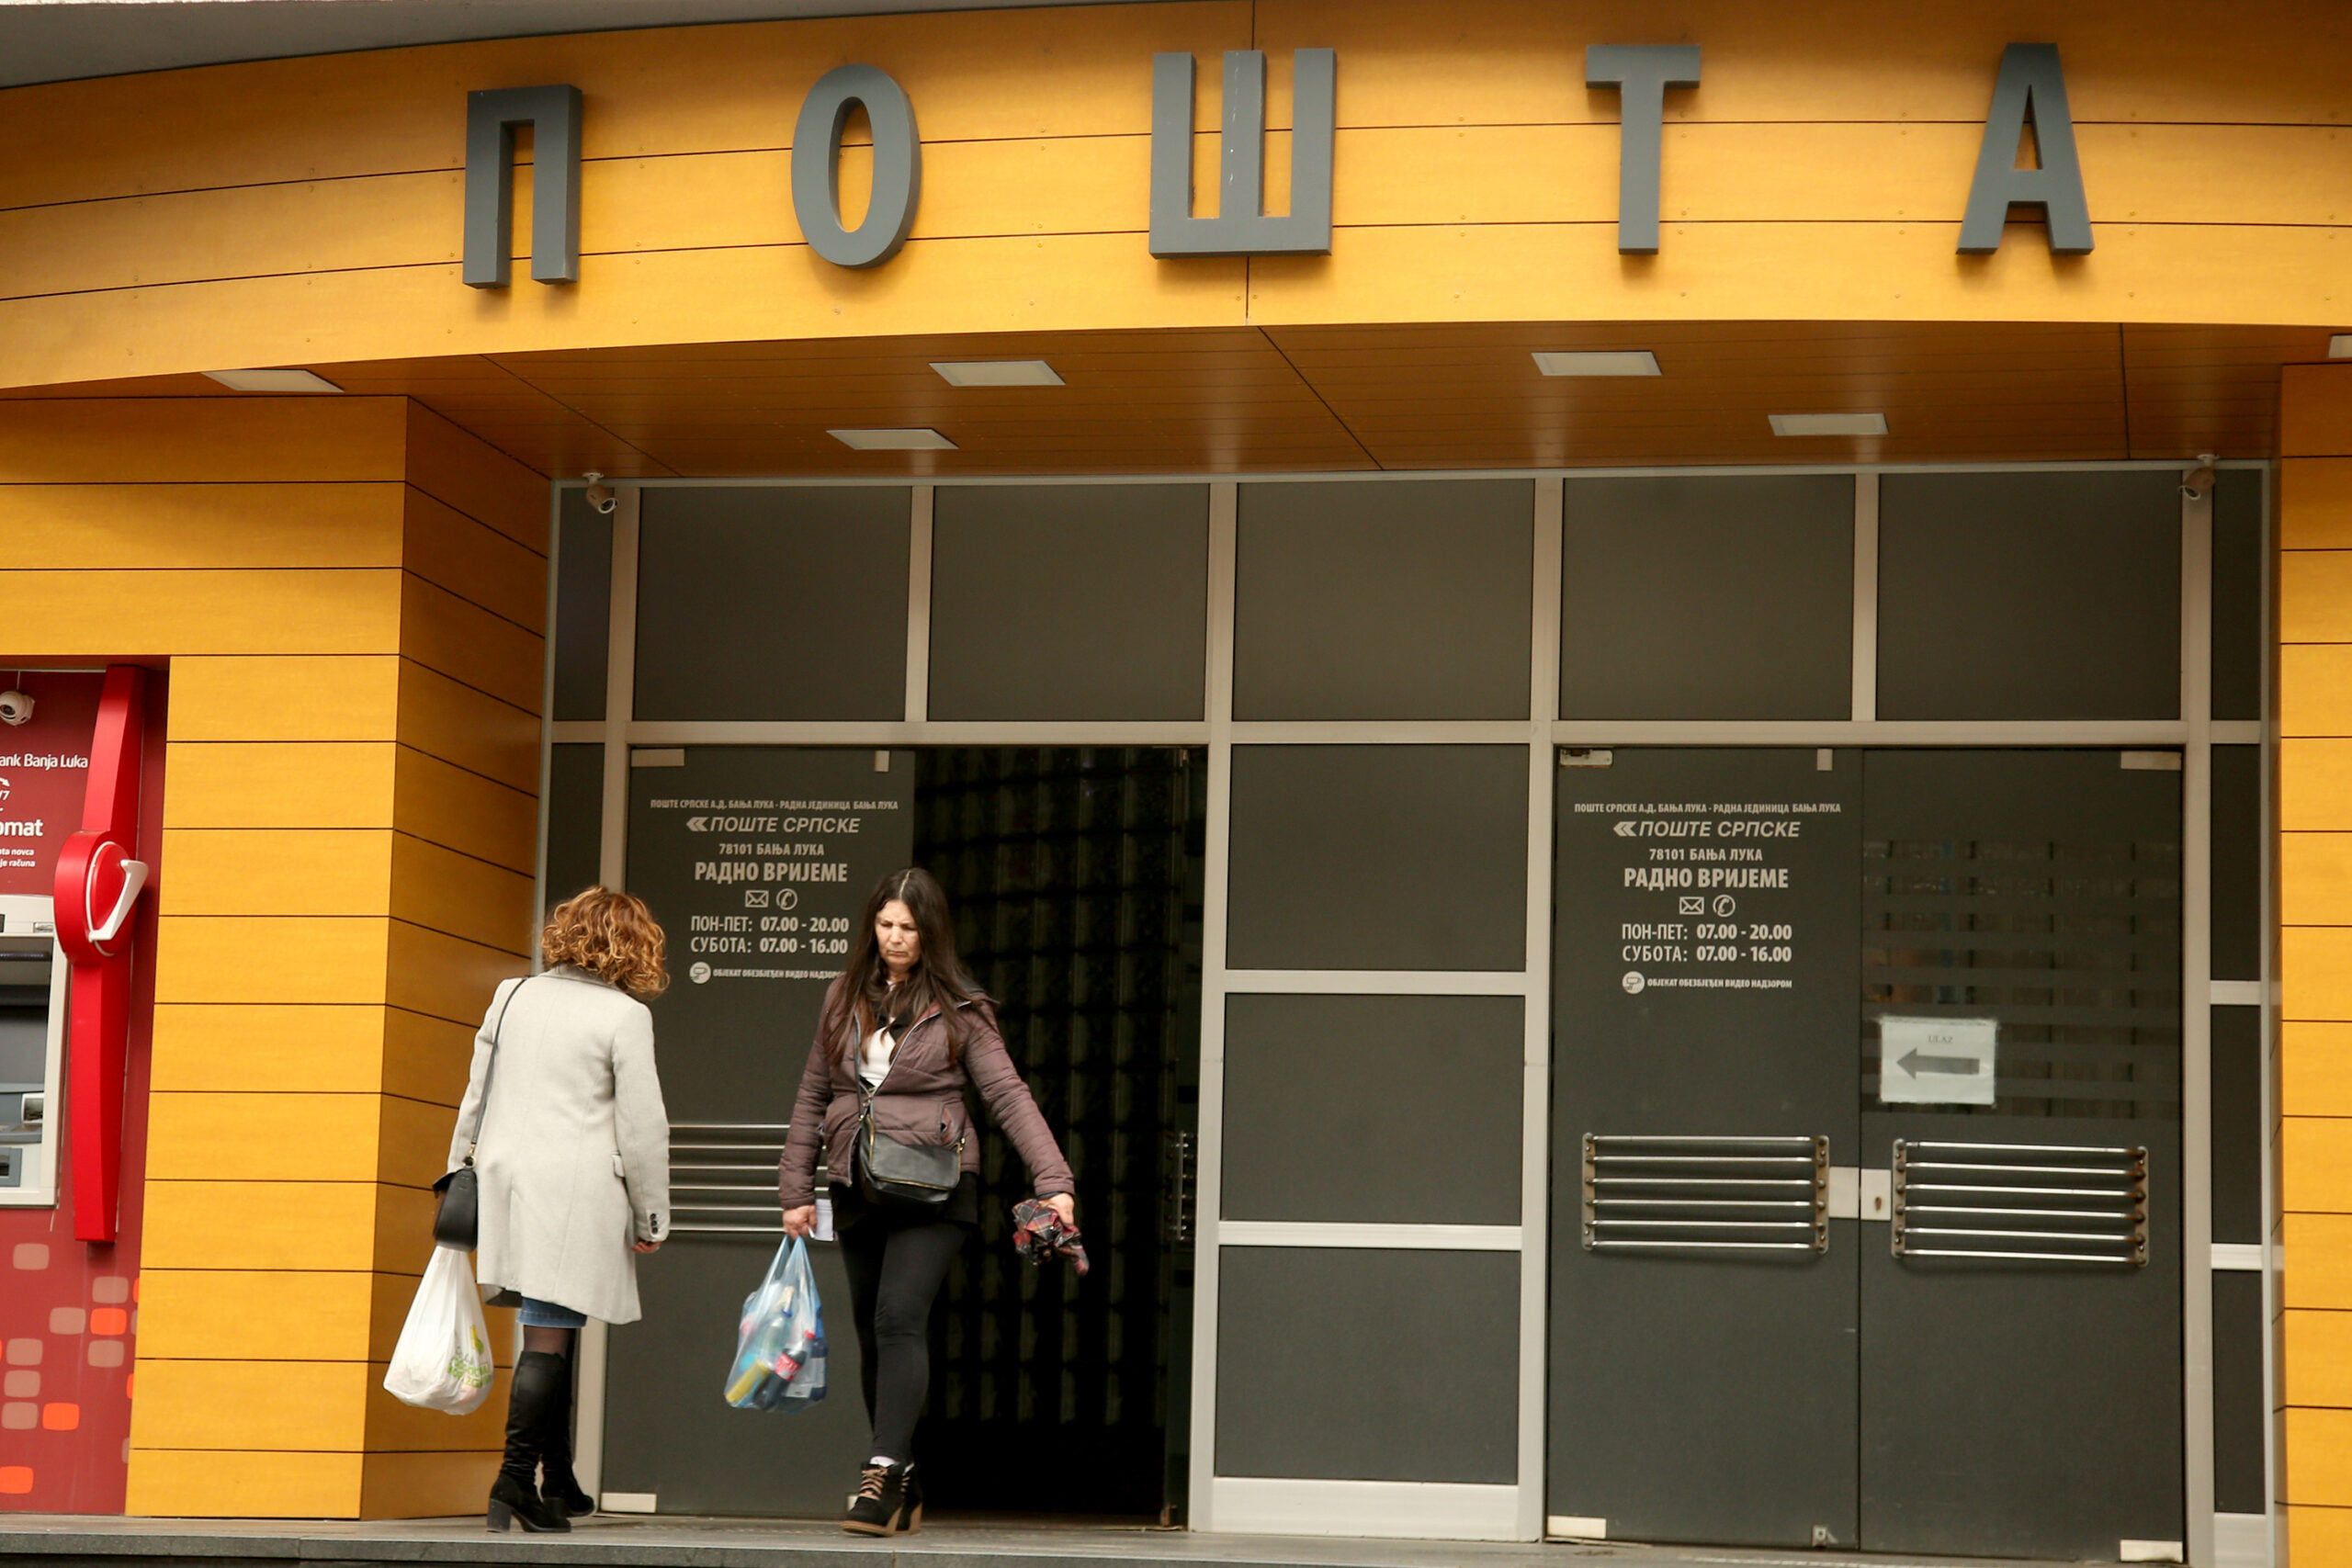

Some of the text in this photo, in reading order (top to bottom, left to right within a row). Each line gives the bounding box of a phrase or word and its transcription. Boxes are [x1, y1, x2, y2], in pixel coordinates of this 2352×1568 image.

[463, 42, 2095, 290] ПОШТА
[24, 753, 58, 771] Banja
[60, 754, 88, 768] Luka
[650, 799, 678, 808] ПОШТЕ
[680, 800, 708, 808] СРПСКЕ
[710, 800, 727, 809] А.Д.
[729, 800, 752, 808] БАЊА
[753, 800, 774, 808] ЛУКА
[780, 800, 807, 810] РАДНА
[808, 801, 850, 810] ЈЕДИНИЦА
[854, 801, 876, 809] БАЊА
[877, 801, 898, 809] ЛУКА
[1575, 804, 1604, 812] ПОШТЕ
[1606, 804, 1636, 812] СРПСКЕ
[1638, 804, 1657, 814] А.Д.
[1658, 804, 1683, 812] БАЊА
[1685, 804, 1706, 812] ЛУКА
[1713, 804, 1742, 814] РАДНА
[1744, 804, 1789, 814] ЈЕДИНИЦА
[1792, 804, 1817, 812] БАЊА
[1818, 804, 1840, 812] ЛУКА
[710, 817, 860, 832] ПОШТЕ СРПСКЕ
[1639, 821, 1801, 837] ПОШТЕ СРПСКЕ
[719, 843, 824, 855] 78101 БАЊА ЛУКА
[1649, 849, 1762, 861] 78101 БАЊА ЛУКА
[8, 859, 36, 867] računa
[695, 862, 847, 884] РАДНО ВРИЈЕМЕ
[1624, 868, 1788, 891] РАДНО ВРИЈЕМЕ
[691, 916, 752, 931] ПОН-ПЕТ:
[761, 917, 798, 931] 07.00
[809, 918, 849, 932] 20.00
[1623, 924, 1687, 940] ПОН-ПЕТ:
[1697, 924, 1737, 939] 07.00
[1749, 924, 1792, 940] 20.00
[691, 937, 752, 953] СУБОТА:
[760, 938, 797, 953] 07.00
[809, 939, 848, 953] 16.00
[1623, 945, 1687, 962] СУБОТА:
[1697, 946, 1736, 961] 07.00
[1750, 946, 1792, 962] 16.00
